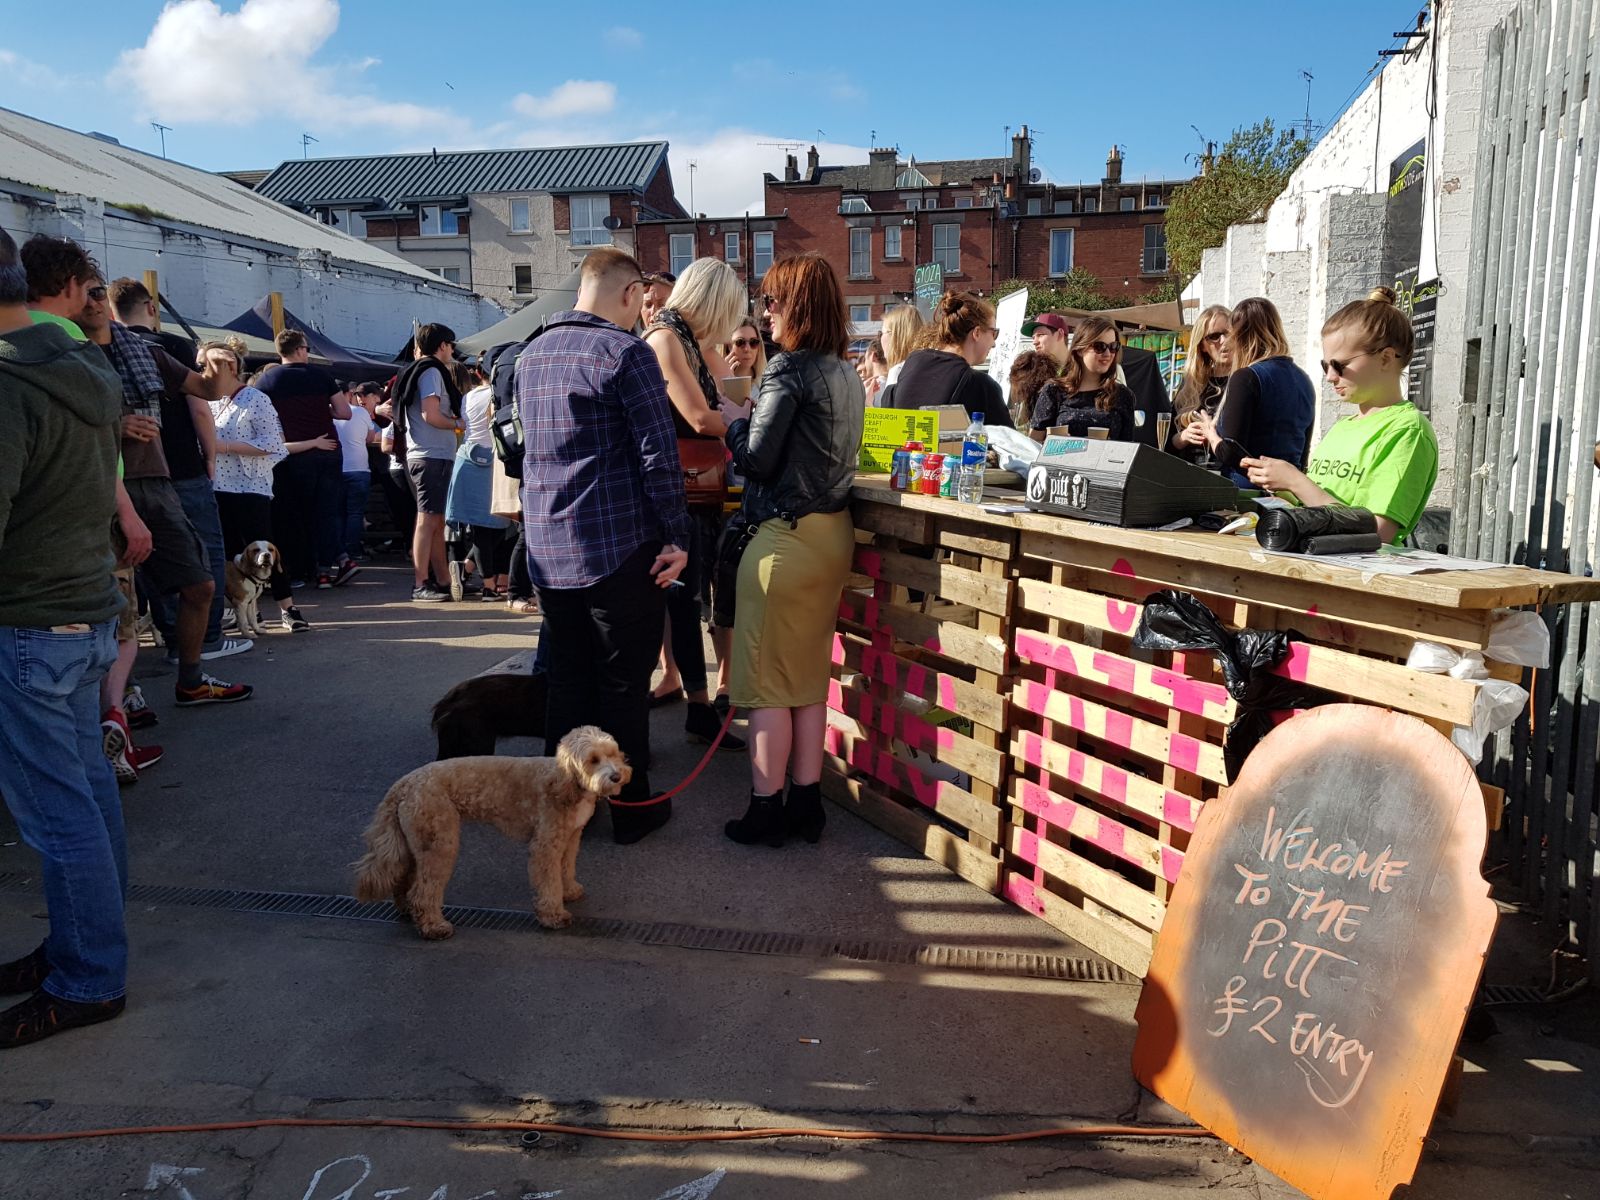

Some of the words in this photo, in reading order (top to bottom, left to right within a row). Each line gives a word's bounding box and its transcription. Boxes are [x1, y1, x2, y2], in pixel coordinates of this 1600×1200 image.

[915, 263, 941, 284] GYOZA
[864, 412, 898, 421] EDINBURGH
[864, 433, 889, 442] FESTIVAL
[1050, 471, 1069, 503] pitt
[1261, 805, 1409, 893] WELCOME
[1287, 881, 1371, 943] THE
[1206, 975, 1284, 1045] £2
